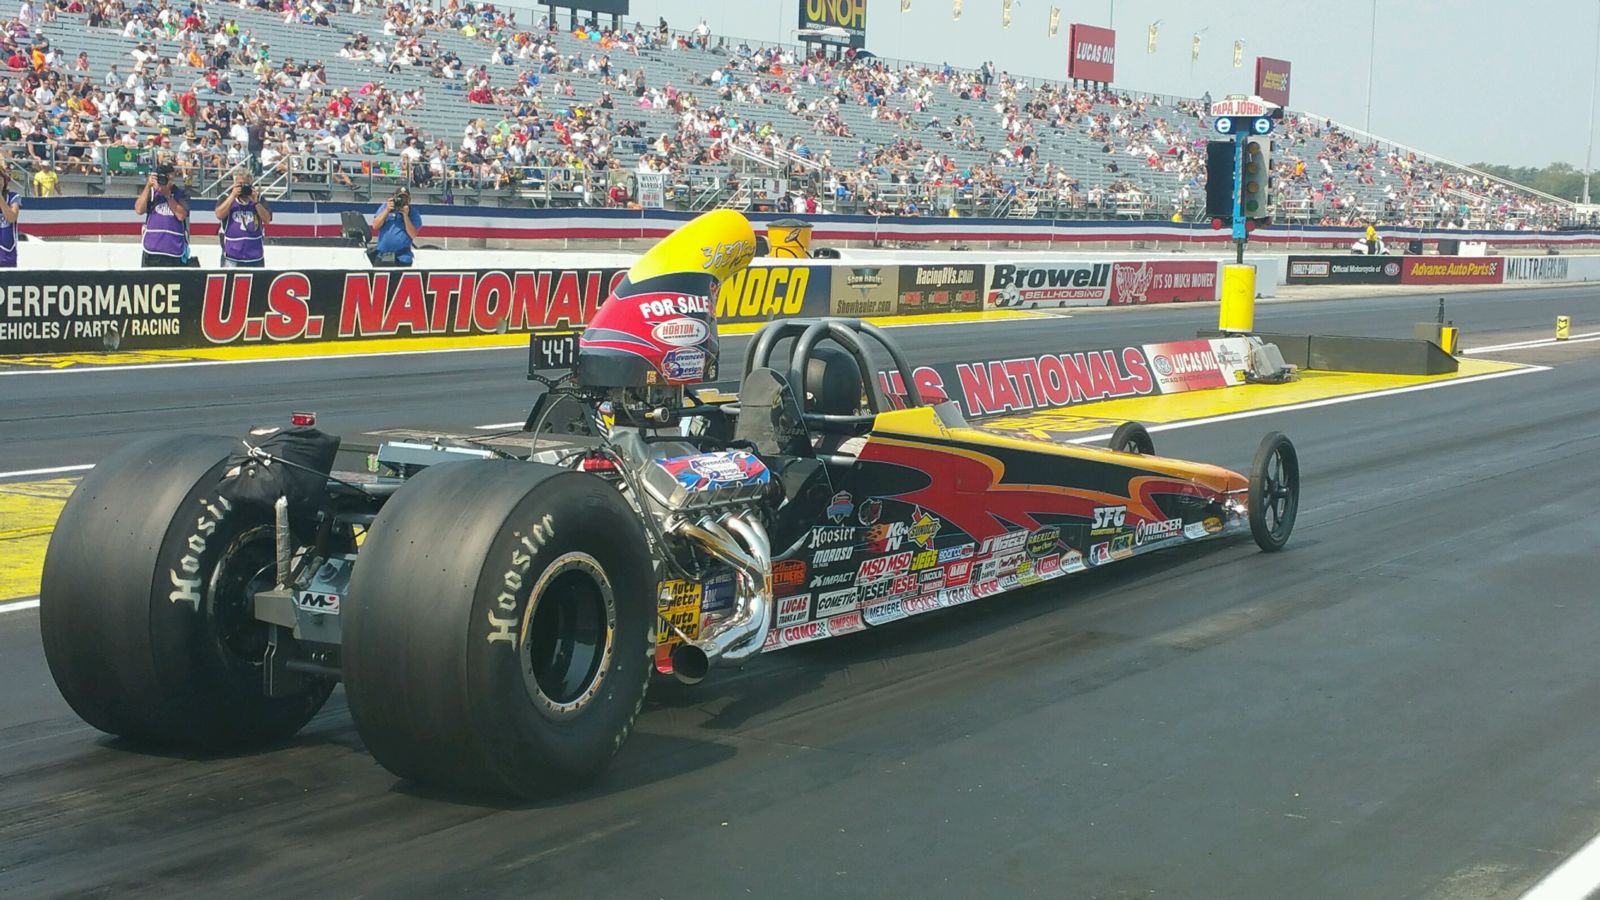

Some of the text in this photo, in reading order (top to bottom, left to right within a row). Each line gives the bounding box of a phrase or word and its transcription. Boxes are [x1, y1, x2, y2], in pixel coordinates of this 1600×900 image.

[807, 0, 865, 29] UNOH
[1076, 42, 1114, 64] LUCAS OIL
[1212, 102, 1233, 115] PAPA
[916, 266, 974, 287] RacingRVs.com
[991, 263, 1111, 290] Browell
[1332, 265, 1349, 273] Official
[1349, 265, 1375, 275] Motorcycle
[1411, 263, 1489, 276] Advance Auto Parts
[1164, 275, 1173, 288] SO
[1174, 273, 1191, 288] MUCH
[0, 283, 181, 318] ERFORMANCE
[1024, 288, 1104, 300] BELLHOUSING
[202, 270, 630, 344] U.S. NATIONAL
[639, 295, 709, 318] FOR SALE
[132, 318, 180, 336] RACING
[662, 323, 694, 336] HORTON
[1171, 354, 1203, 374] LUCAS
[1201, 351, 1219, 371] OIL
[956, 346, 1154, 417] NATIONALS
[1091, 506, 1127, 529] SFG
[1145, 518, 1183, 536] MOSER
[808, 524, 856, 549] Hoosier
[813, 547, 854, 564] MOROSO
[912, 552, 938, 570] JEGS
[861, 553, 912, 578] MSD MSD
[672, 582, 695, 595] Auto
[821, 572, 855, 587] IMPACT
[857, 573, 919, 601] JESEL JESEL
[669, 594, 699, 607] Meter
[780, 596, 808, 615] LUCAS
[818, 590, 856, 610] COMETIC
[670, 612, 693, 625] Auto
[869, 602, 901, 618] MEZIERE
[829, 614, 860, 631] SIMPSON
[784, 622, 817, 642] COMP
